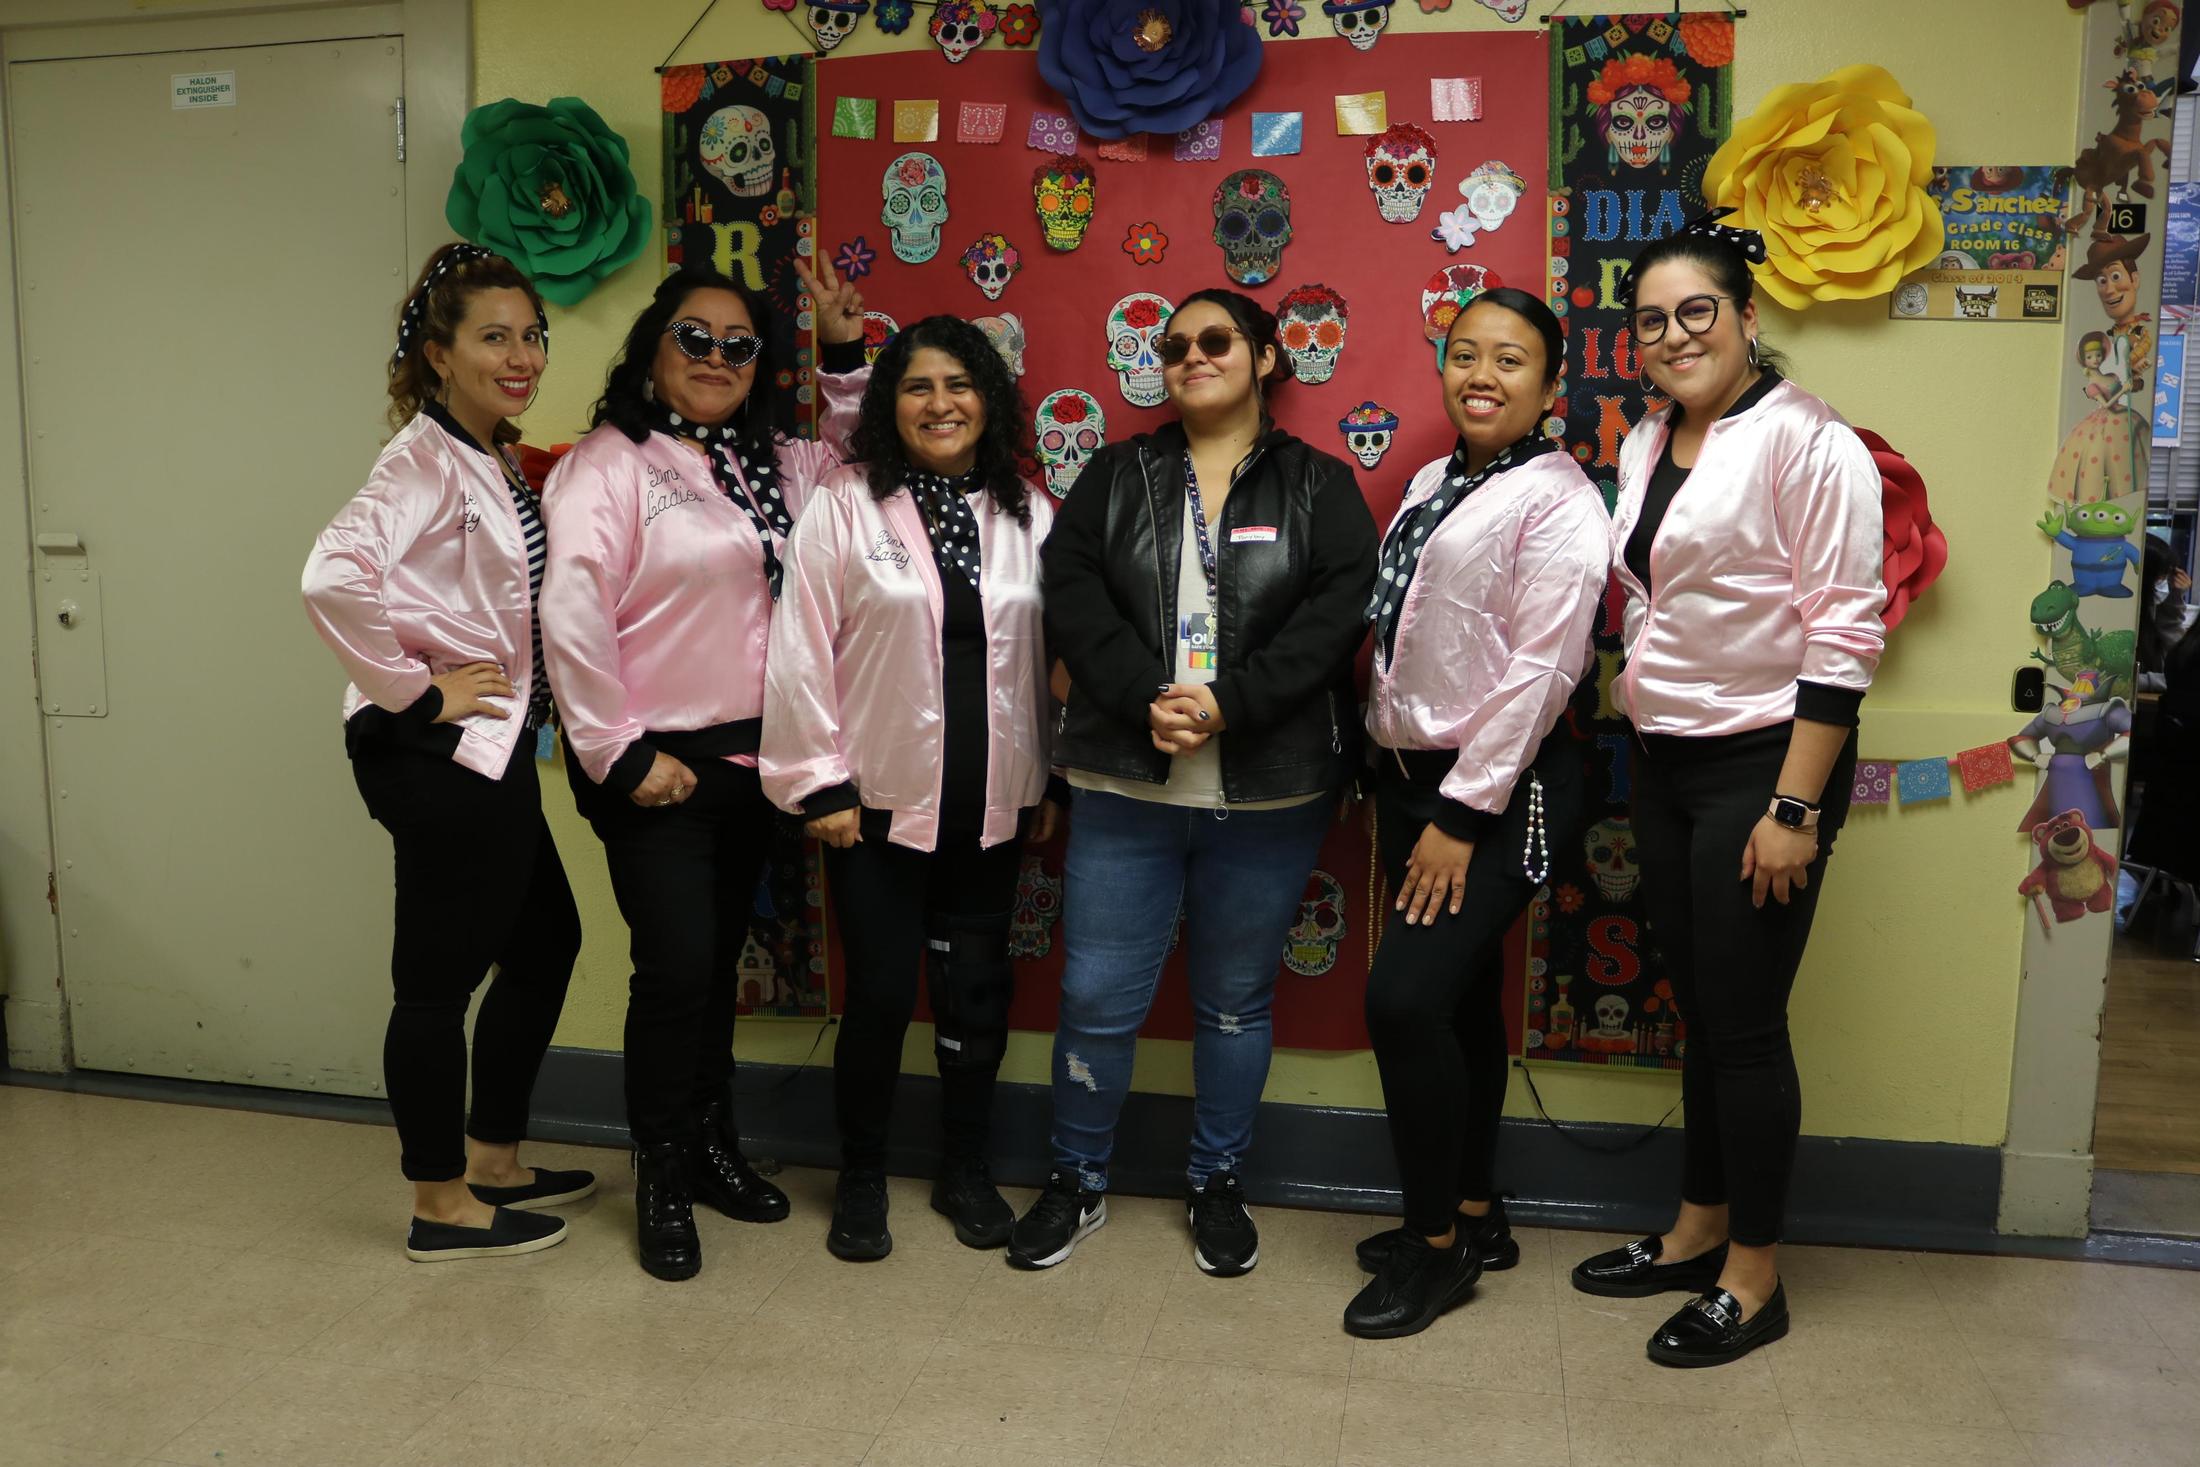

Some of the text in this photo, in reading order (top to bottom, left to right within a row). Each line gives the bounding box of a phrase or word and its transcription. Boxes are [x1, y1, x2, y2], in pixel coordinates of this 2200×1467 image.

[176, 84, 231, 96] EXTINGUISHER
[189, 77, 217, 86] HALON
[189, 94, 219, 104] INSIDE
[1951, 187, 2061, 214] Sanchez
[1582, 189, 1686, 242] DIA
[2111, 208, 2134, 229] 16
[1947, 219, 2054, 242] Grade Class
[1950, 239, 2021, 250] ROOM 16
[864, 545, 911, 570] Lady
